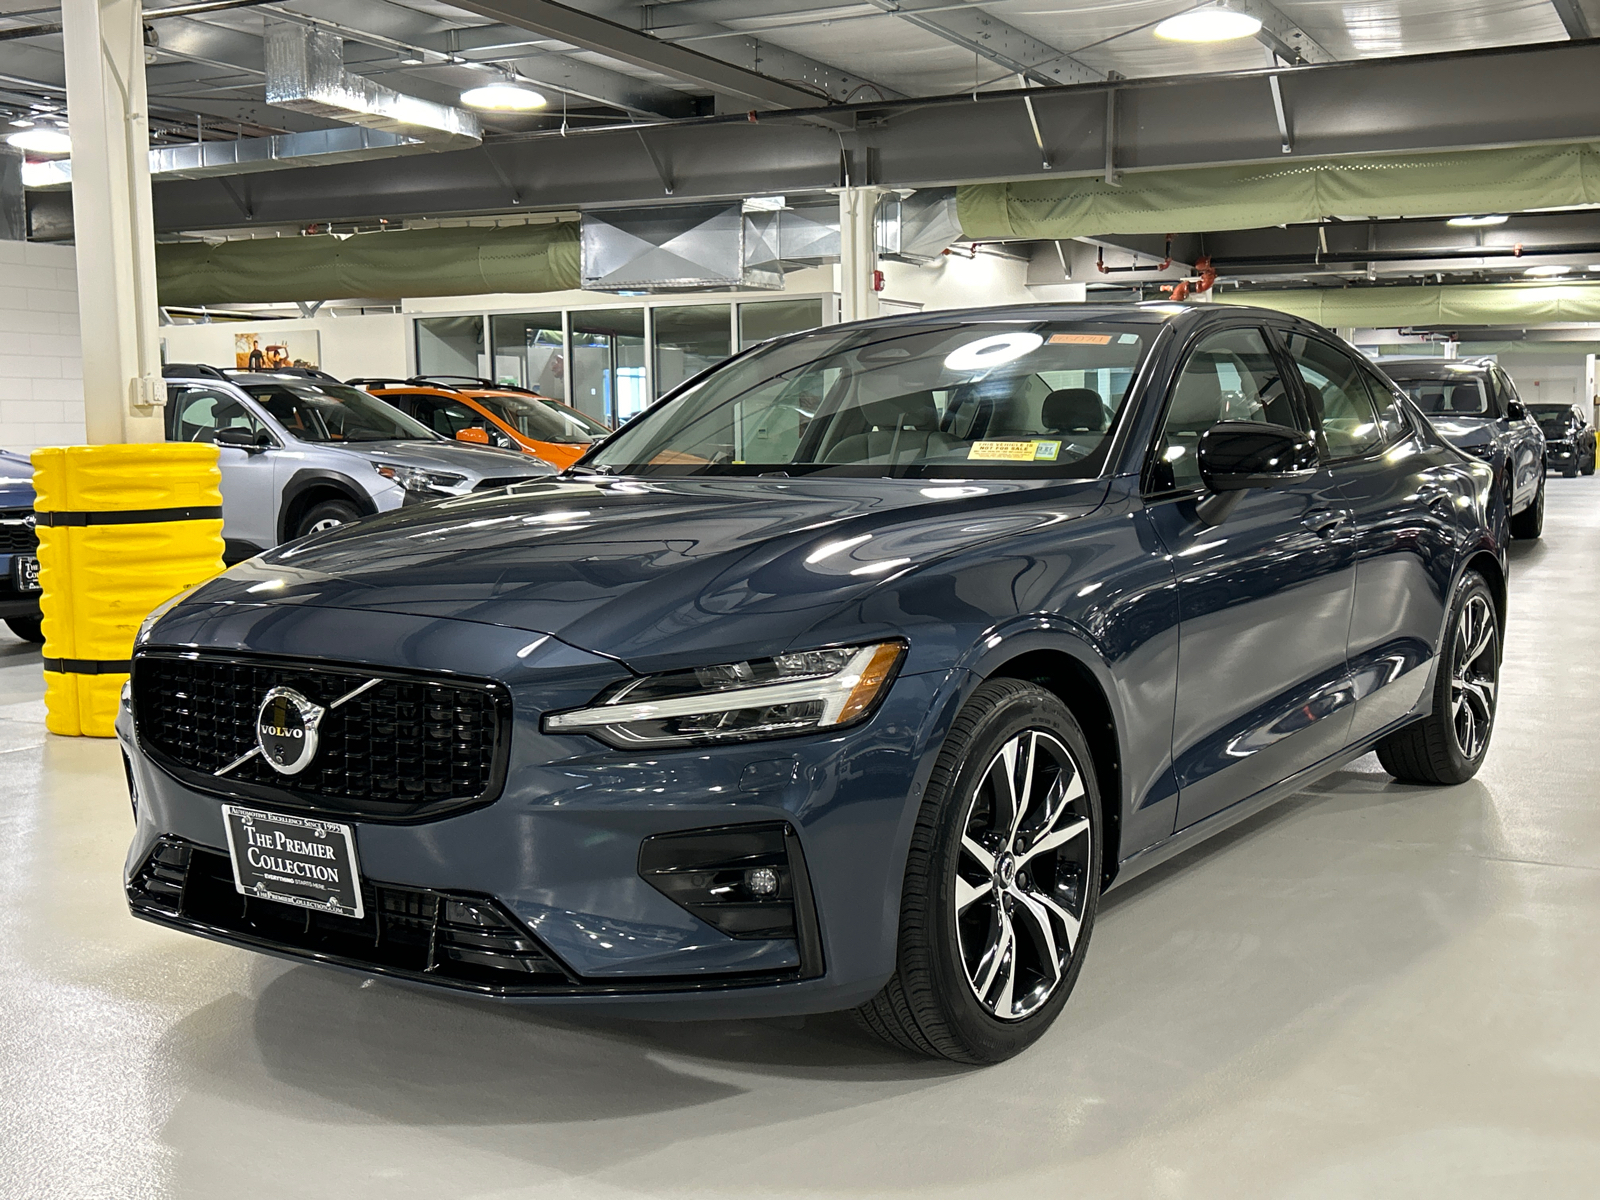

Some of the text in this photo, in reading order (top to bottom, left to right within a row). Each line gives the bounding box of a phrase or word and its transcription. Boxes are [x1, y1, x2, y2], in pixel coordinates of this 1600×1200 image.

[261, 724, 303, 739] VOLVO
[231, 807, 341, 832] AUTOMOTIVE EXCELLENCE SINCE 1995
[244, 825, 336, 861] THE PREMIER
[247, 847, 340, 883] COLLECTION
[264, 873, 295, 884] EVERYTHING
